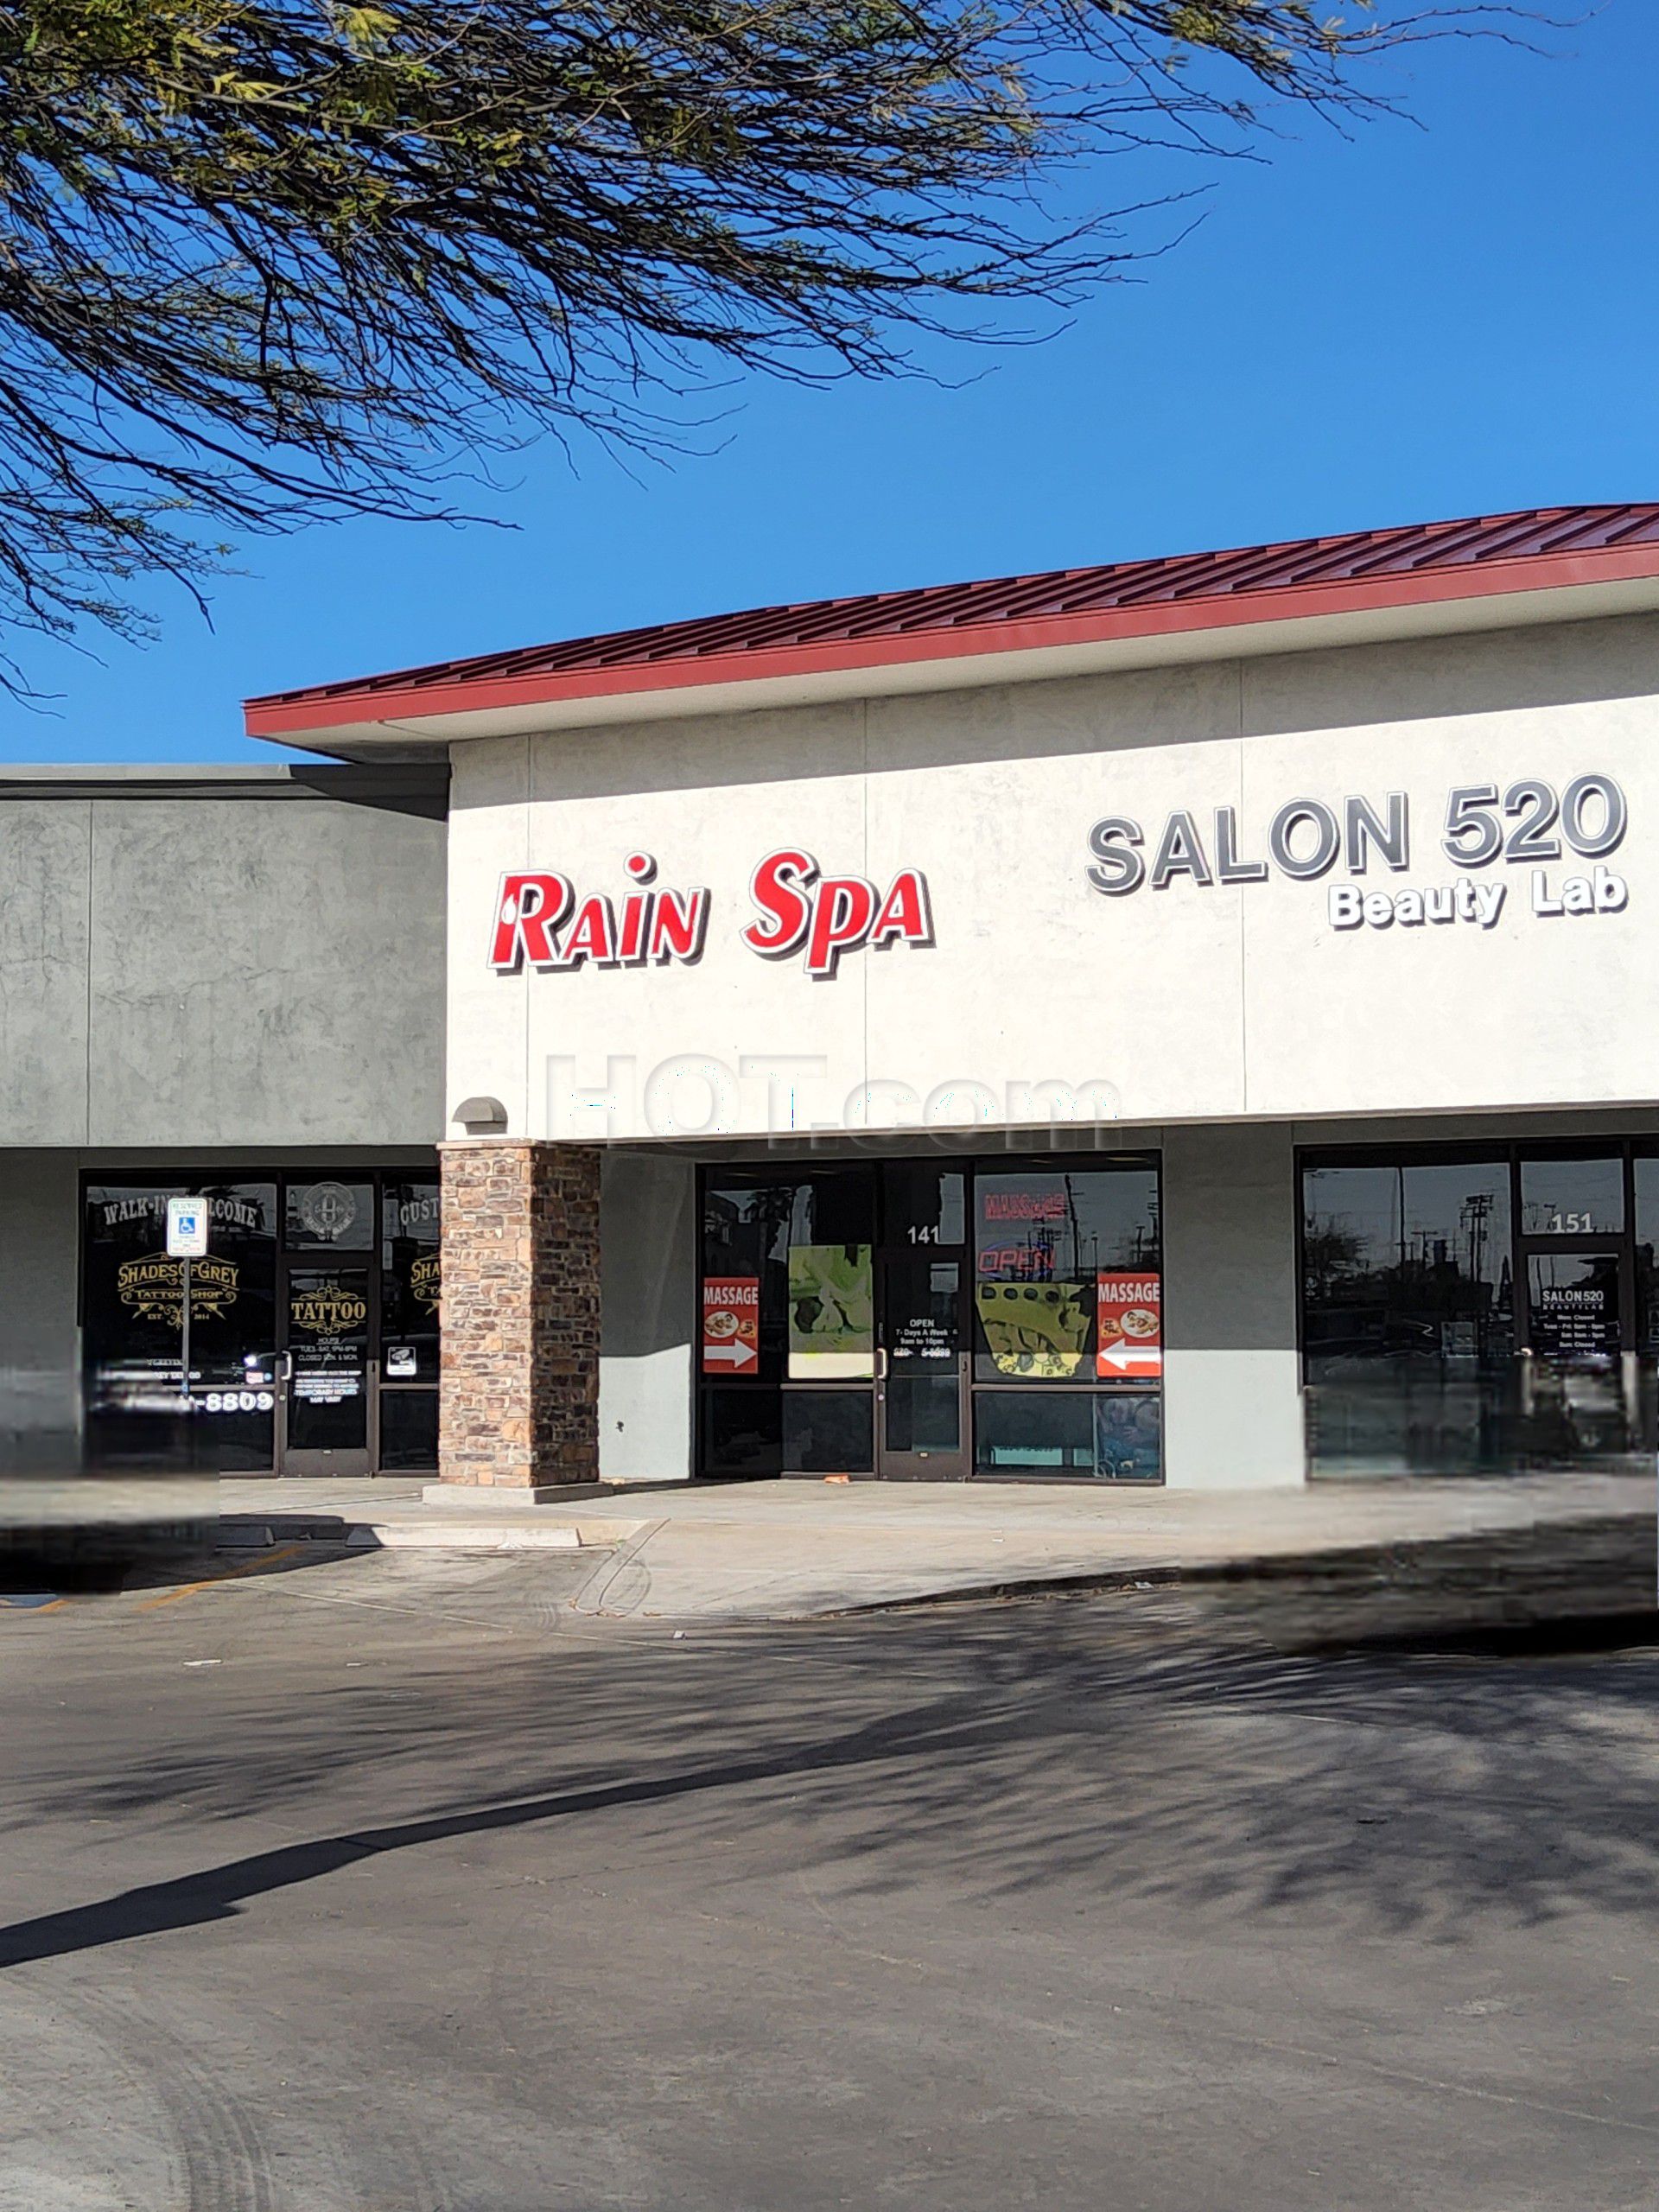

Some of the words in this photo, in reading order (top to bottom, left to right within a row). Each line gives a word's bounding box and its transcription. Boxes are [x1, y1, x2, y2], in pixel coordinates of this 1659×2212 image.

[1085, 791, 1408, 895] SALON
[1440, 772, 1627, 868] 520
[1328, 878, 1507, 930] Beauty
[1530, 866, 1628, 916] Lab
[104, 1195, 168, 1225] WALK-IN
[400, 1198, 439, 1225] CUST
[907, 1224, 939, 1244] 141
[1551, 1212, 1594, 1234] 151
[410, 1261, 440, 1284] SHA
[703, 1286, 759, 1306] MASSAGE
[1098, 1282, 1160, 1303] MASSAGE
[290, 1302, 366, 1321] TATTOO
[909, 1319, 935, 1327] OPEN
